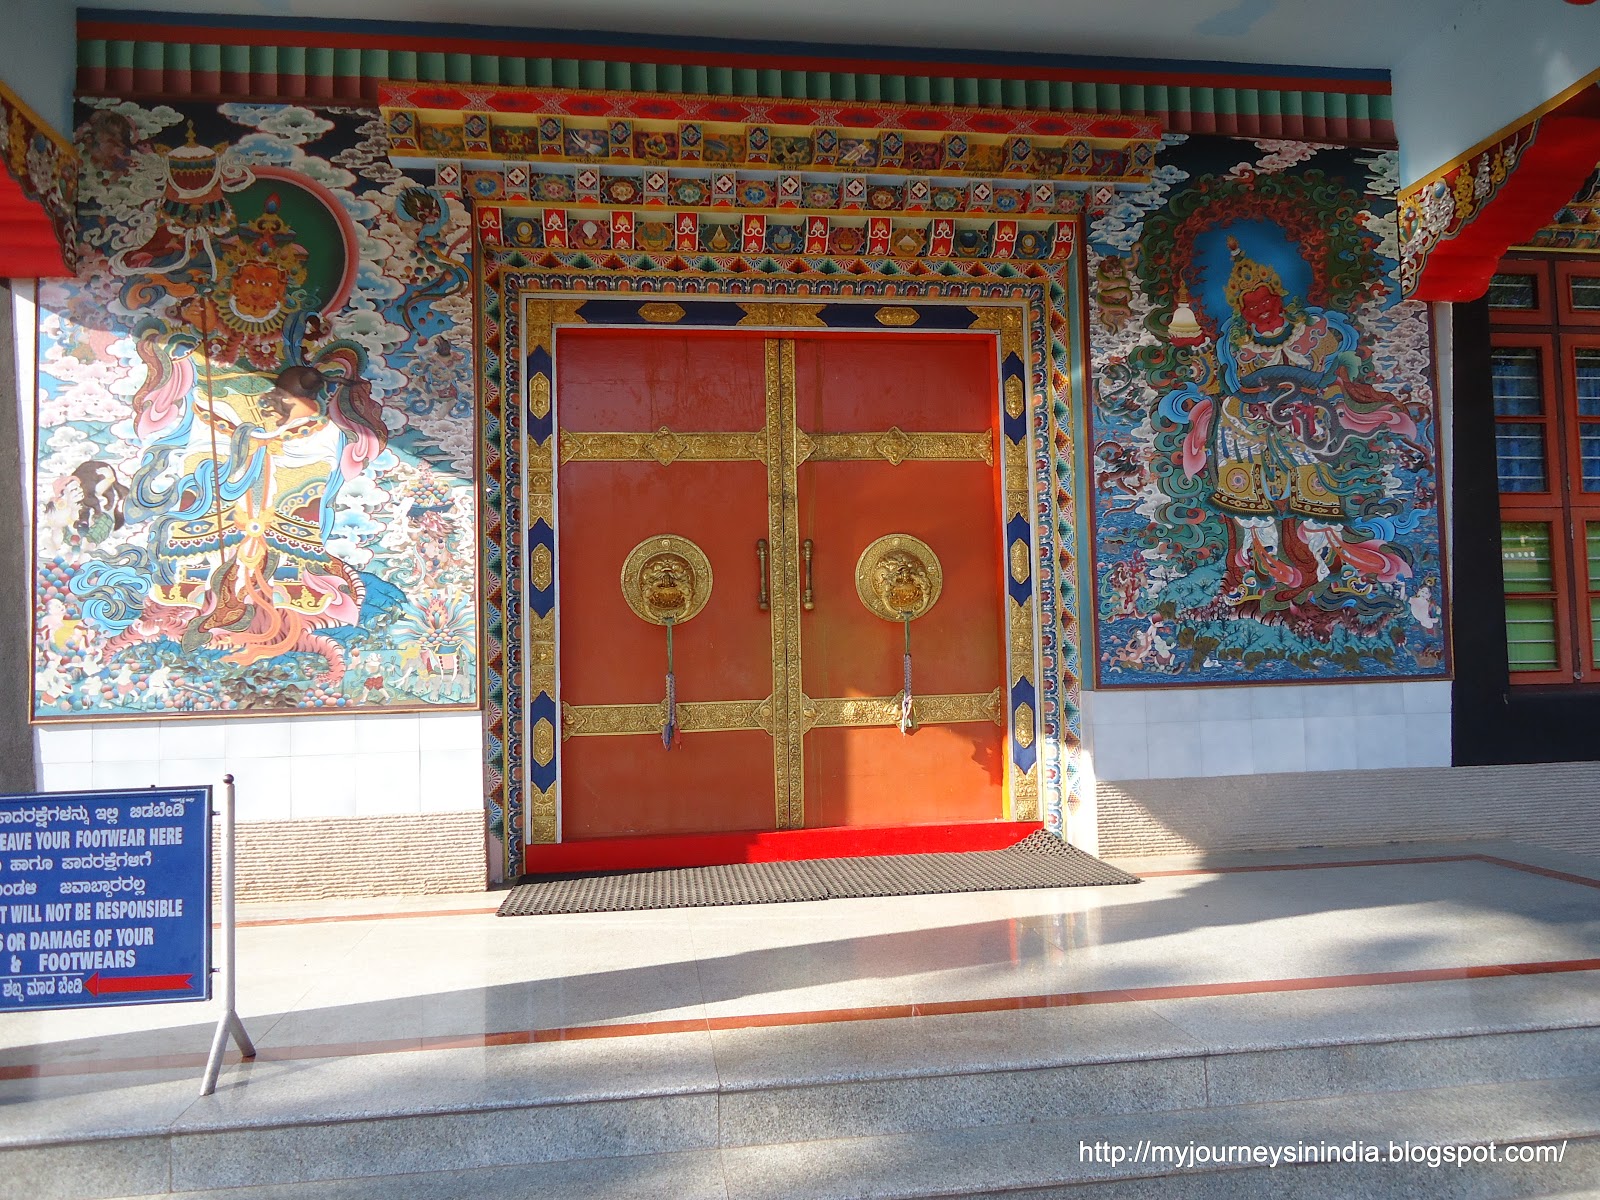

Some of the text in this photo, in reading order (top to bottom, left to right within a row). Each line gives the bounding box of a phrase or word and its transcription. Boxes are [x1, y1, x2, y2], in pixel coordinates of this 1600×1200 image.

[94, 807, 119, 825] ಇಲ್ಲಿ
[0, 826, 183, 851] EAVE YOUR FOOTWEAR HERE
[10, 855, 54, 871] ಹಾಗೂ
[11, 904, 42, 924] WILL
[45, 903, 72, 922] NOT
[75, 902, 91, 921] BE
[95, 899, 183, 920] RESPONSIBLE
[7, 933, 26, 952] OR
[30, 930, 91, 951] DAMAGE
[94, 929, 112, 948] OF
[116, 927, 154, 947] YOUR
[10, 950, 136, 973] & FOOTWEARS
[58, 975, 83, 994] ಬೇಡಿ
